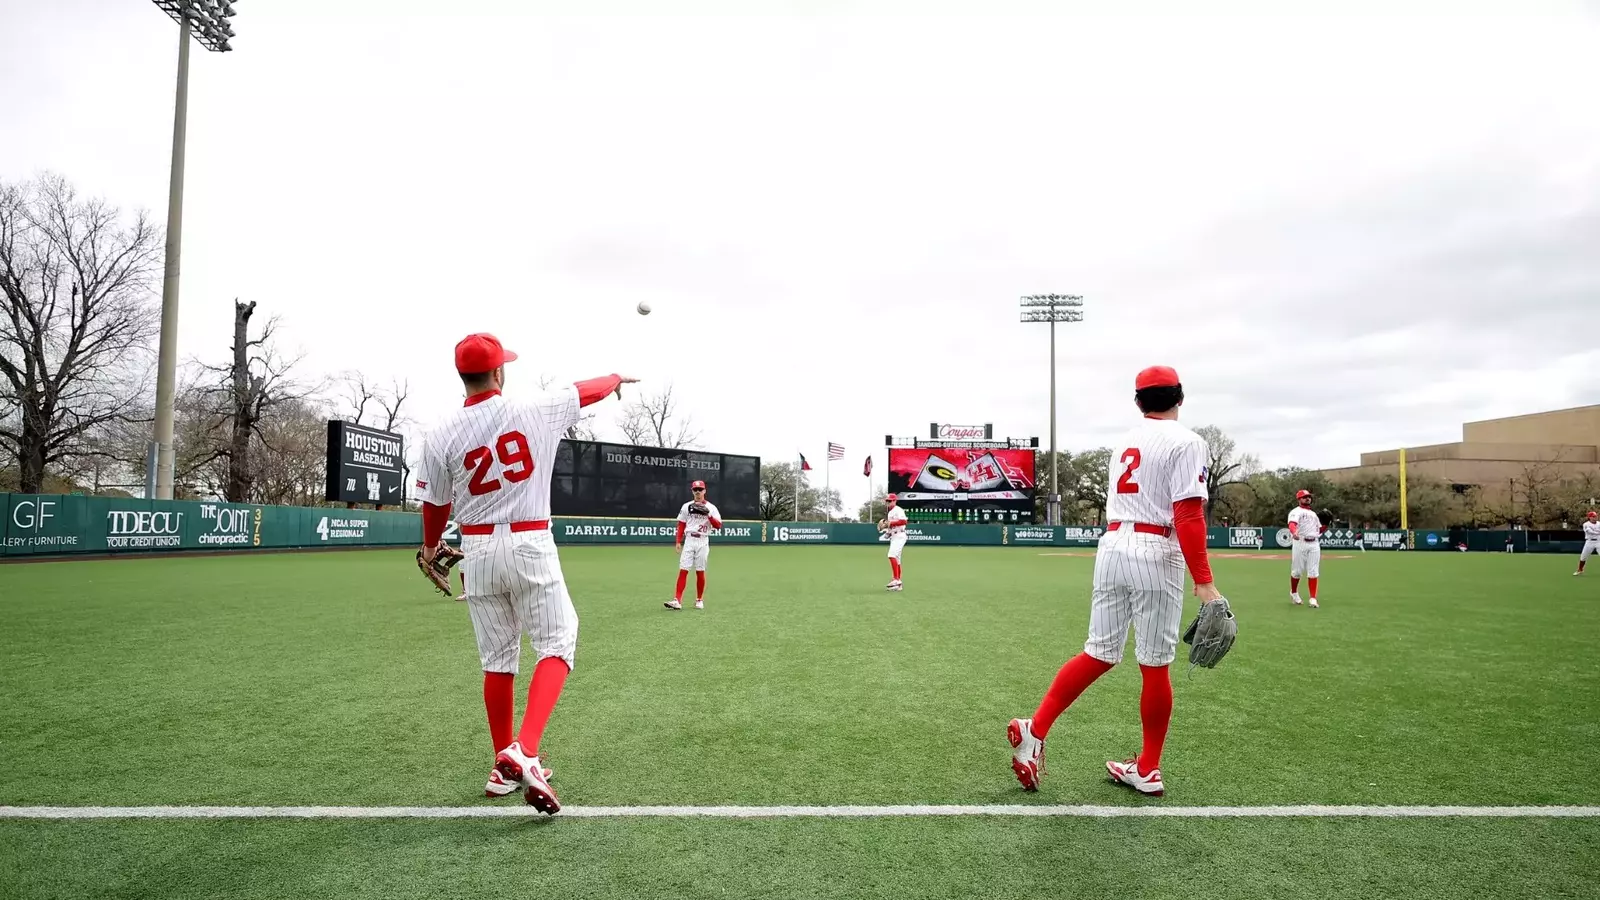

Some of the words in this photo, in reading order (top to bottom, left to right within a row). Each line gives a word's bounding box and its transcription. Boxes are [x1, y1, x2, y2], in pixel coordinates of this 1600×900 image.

[939, 424, 984, 440] Cougars
[345, 431, 400, 457] HOUSTON
[353, 451, 394, 467] BASEBALL
[464, 429, 535, 496] 29
[607, 452, 631, 464] DON
[634, 455, 688, 468] SANDERS
[690, 461, 720, 471] FIELD
[1117, 447, 1141, 494] 2
[200, 504, 217, 519] THE
[107, 511, 184, 534] TDECU
[316, 516, 330, 541] 4
[330, 519, 347, 527] NCAA
[349, 519, 369, 528] SUPER
[330, 529, 364, 538] REGIONALS
[565, 525, 618, 536] DARRYL
[620, 526, 628, 536] &
[630, 526, 657, 536] LORI
[724, 527, 751, 537] PARK
[773, 526, 789, 541] 16
[1065, 527, 1103, 538] HR&P
[1235, 529, 1257, 537] BUD
[1363, 532, 1379, 541] KING
[28, 536, 78, 546] FURNITURE
[106, 538, 128, 547] YOUR
[129, 537, 155, 547] CREDIT
[155, 537, 180, 546] UNION
[198, 533, 249, 545] chiropractic
